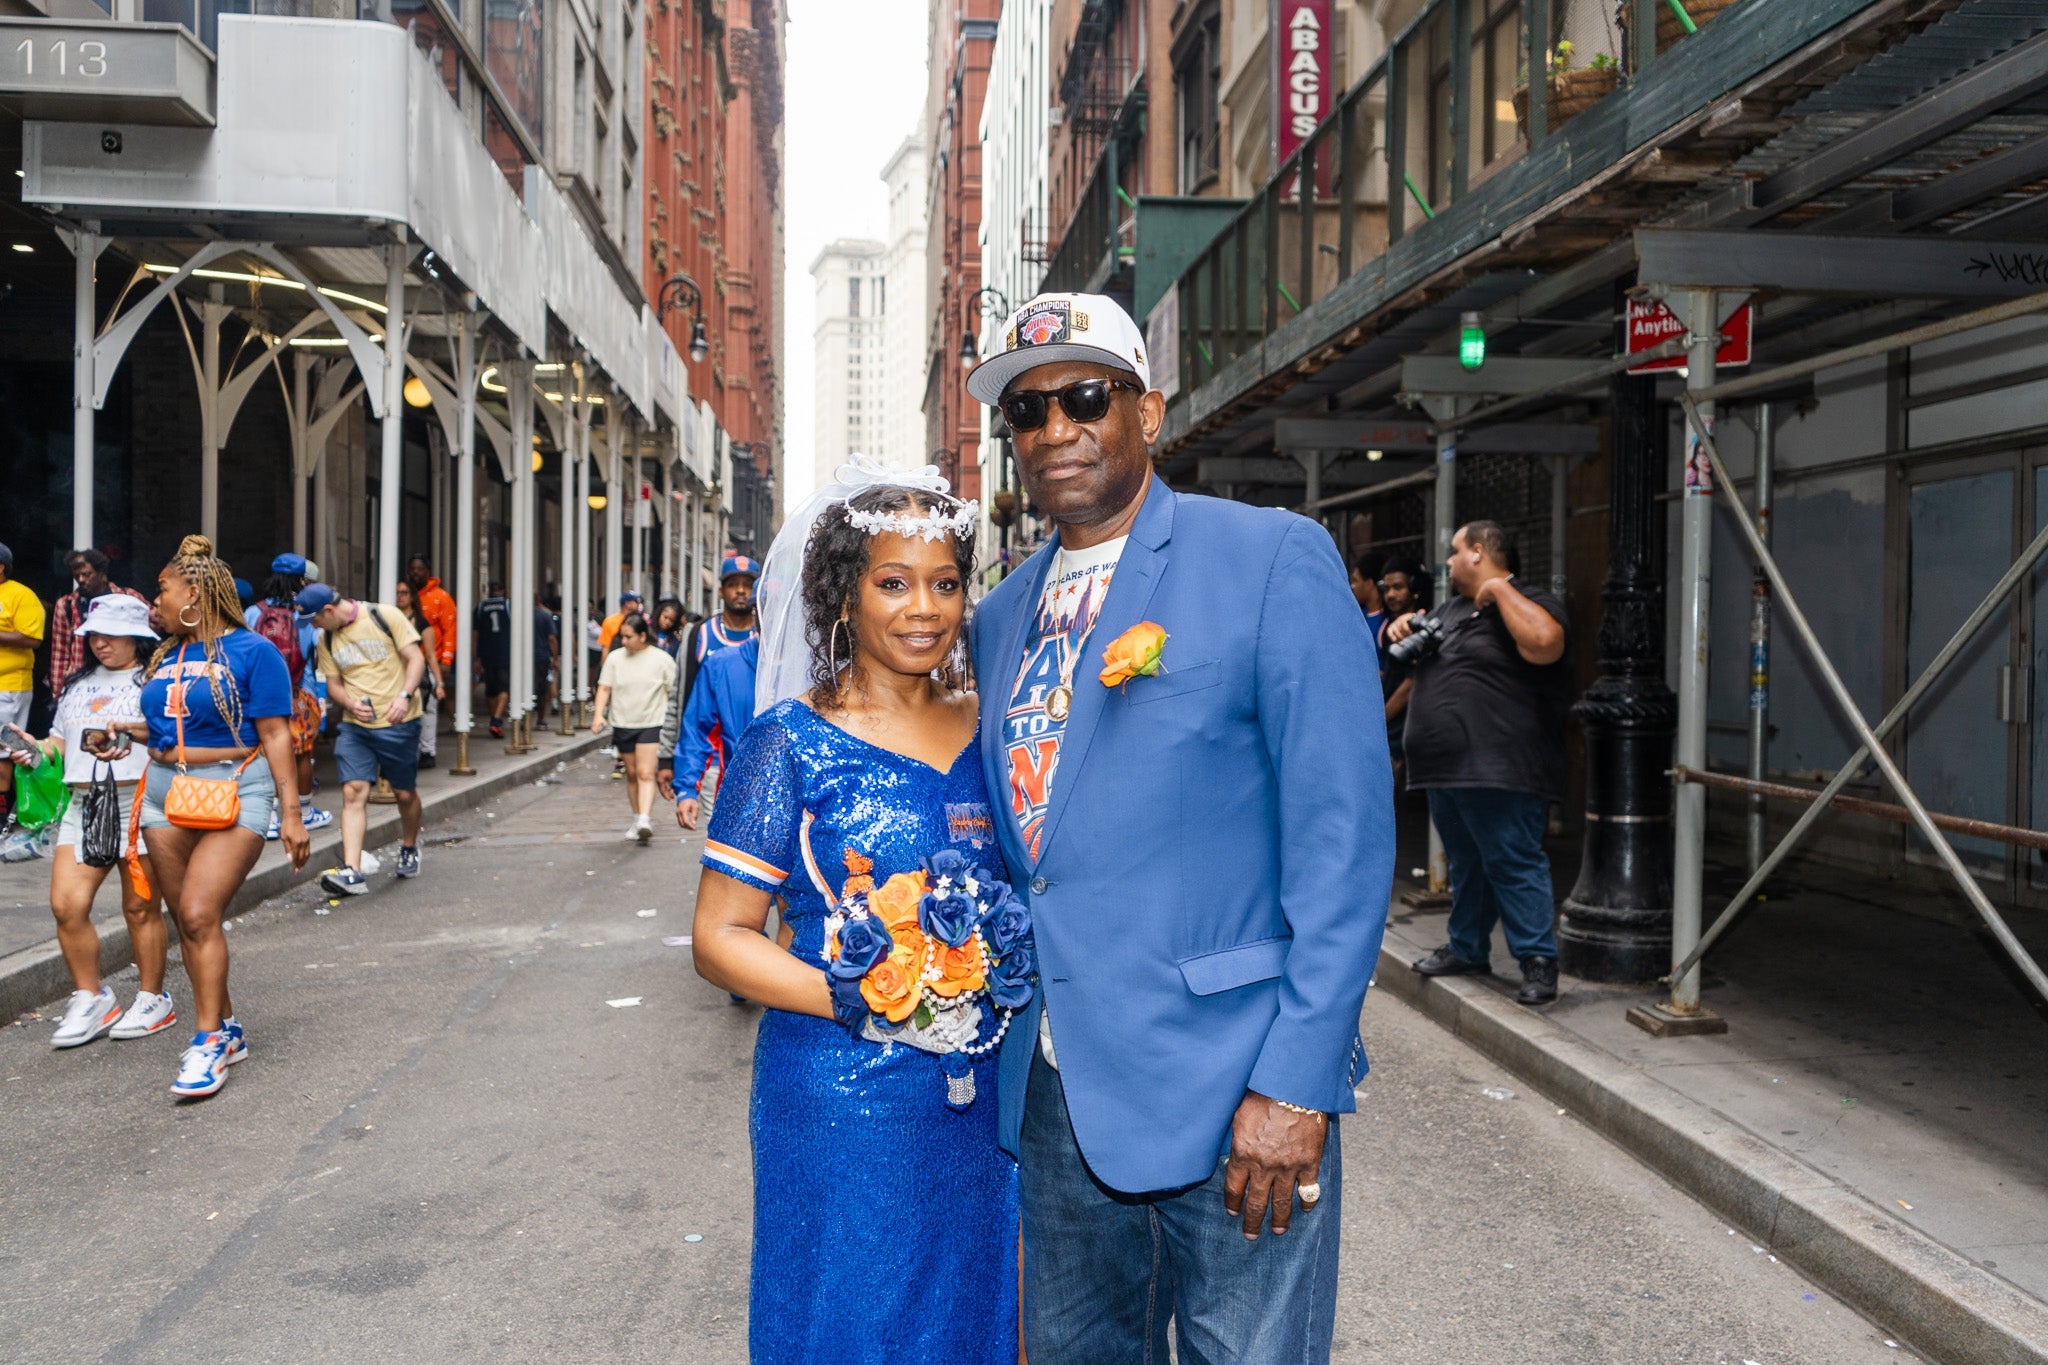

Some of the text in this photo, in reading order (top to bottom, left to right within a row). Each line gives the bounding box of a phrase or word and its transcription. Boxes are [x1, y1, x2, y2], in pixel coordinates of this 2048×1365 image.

[16, 38, 107, 77] 113
[1289, 6, 1321, 138] ABACUS
[1029, 301, 1070, 316] CHAMPIONS
[1046, 580, 1057, 591] 27
[1058, 570, 1084, 584] EARS
[1085, 564, 1100, 575] OF
[490, 611, 500, 632] 1
[1010, 714, 1049, 739] TO
